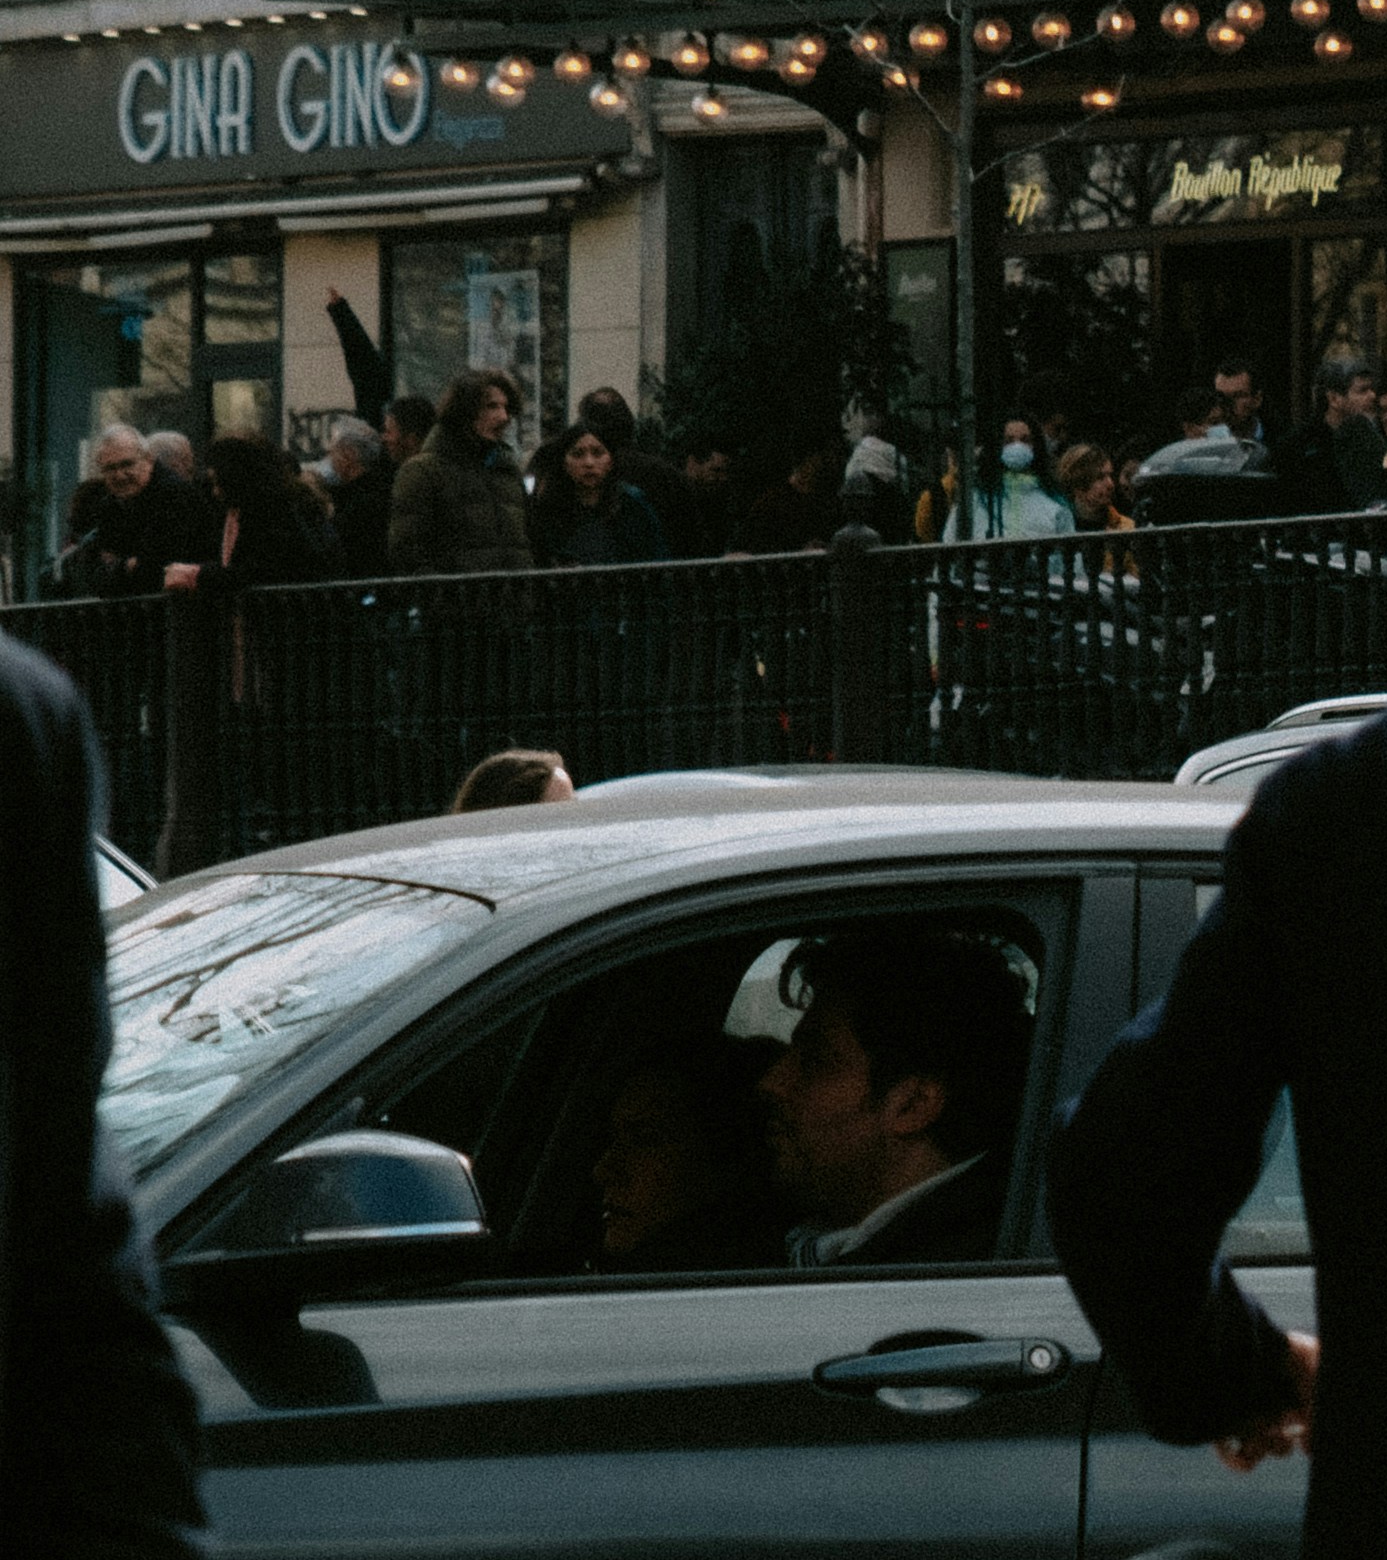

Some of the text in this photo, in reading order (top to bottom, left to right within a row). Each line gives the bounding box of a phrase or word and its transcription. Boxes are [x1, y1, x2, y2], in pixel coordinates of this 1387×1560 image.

[117, 42, 430, 163] GINA GINO
[1170, 151, 1342, 212] Bouillon République
